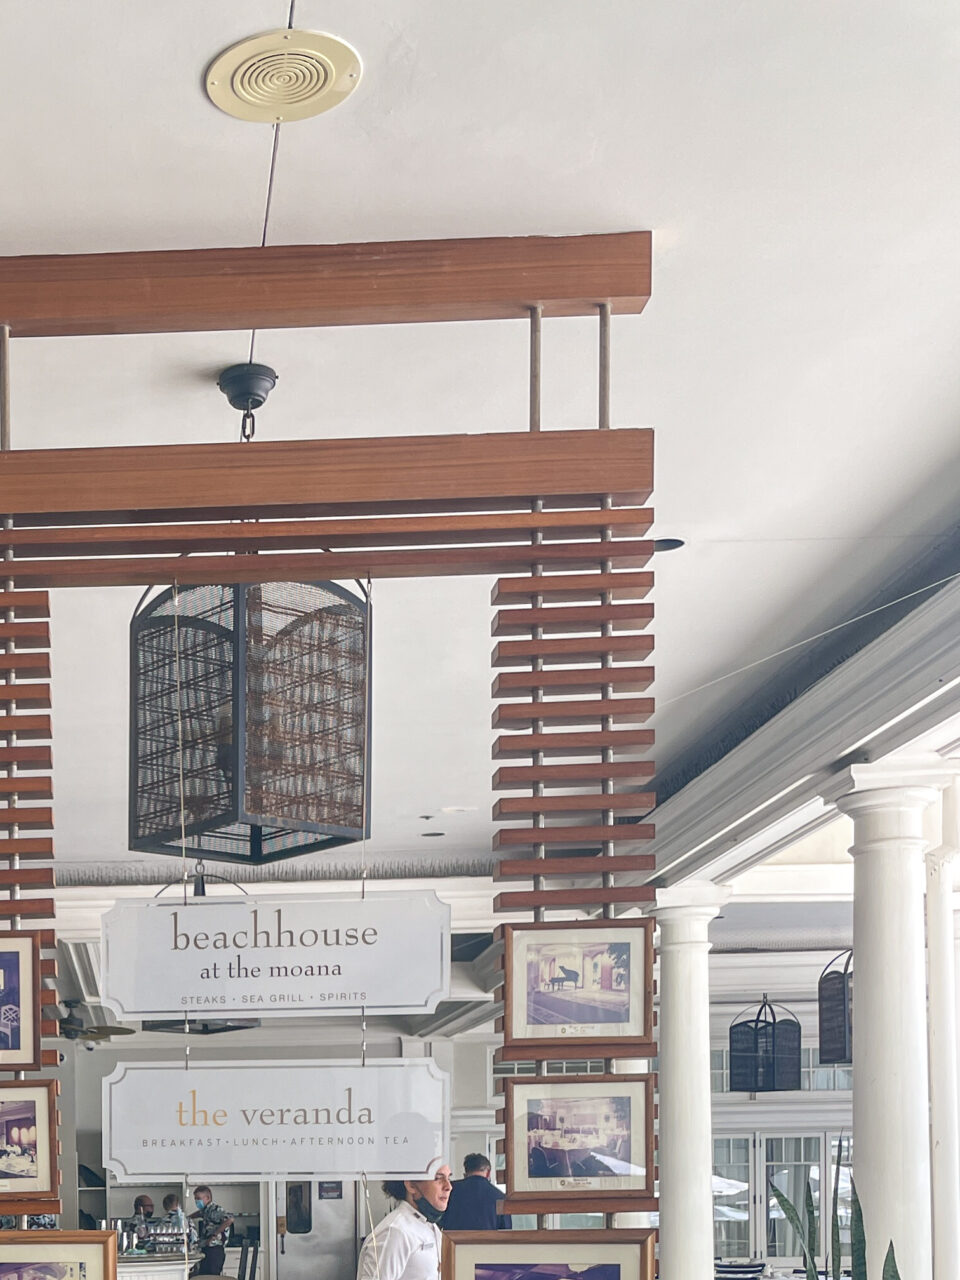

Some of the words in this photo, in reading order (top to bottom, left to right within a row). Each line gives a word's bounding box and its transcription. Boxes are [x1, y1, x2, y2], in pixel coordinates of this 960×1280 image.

[170, 908, 378, 951] beachhouse
[200, 962, 220, 979] at
[227, 954, 261, 978] the
[269, 963, 342, 977] moana
[181, 996, 226, 1005] STEAKS
[241, 994, 264, 1003] SEA
[269, 993, 304, 1003] GRILL
[319, 992, 367, 1001] SPIRITS
[176, 1089, 228, 1127] the
[240, 1087, 375, 1126] veranda
[142, 1138, 221, 1147] BREAKFAST
[233, 1138, 278, 1146] LUNCH
[290, 1137, 375, 1145] AFTERNOON
[384, 1136, 409, 1144] TEA
